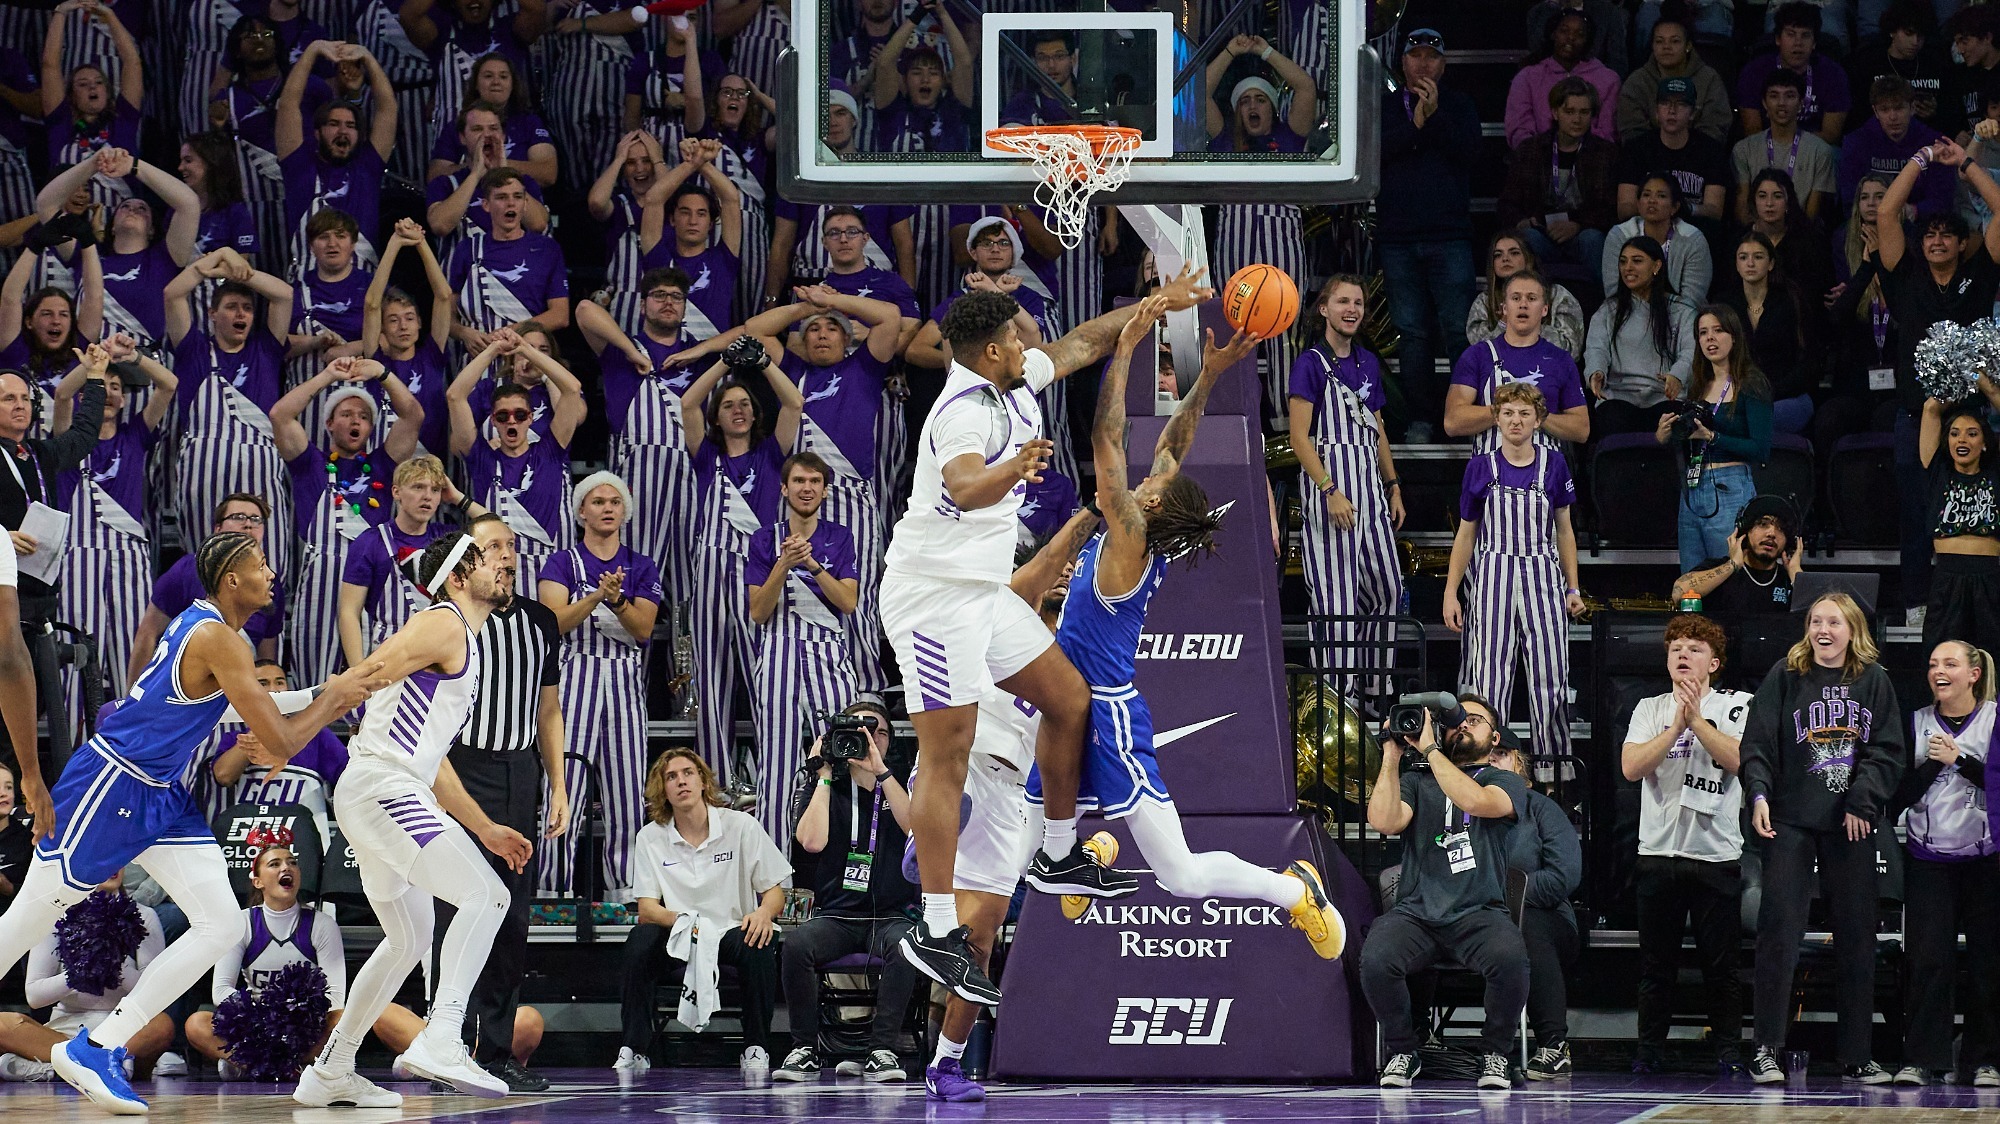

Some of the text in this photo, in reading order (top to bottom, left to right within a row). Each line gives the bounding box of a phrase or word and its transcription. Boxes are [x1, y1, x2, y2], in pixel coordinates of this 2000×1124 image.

[1910, 79, 1940, 89] ANYON
[1230, 283, 1250, 320] ELITE
[1942, 500, 1996, 527] Bright
[1134, 633, 1244, 660] CU.EDU
[129, 639, 169, 701] 2
[1792, 699, 1873, 744] LOPES
[237, 778, 306, 807] GCU
[259, 805, 269, 815] 9
[223, 846, 299, 859] GLOL
[713, 851, 733, 863] GCU
[1074, 898, 1284, 926] ALKING STICK
[1118, 931, 1233, 958] RESORT
[1108, 997, 1235, 1045] GCU
